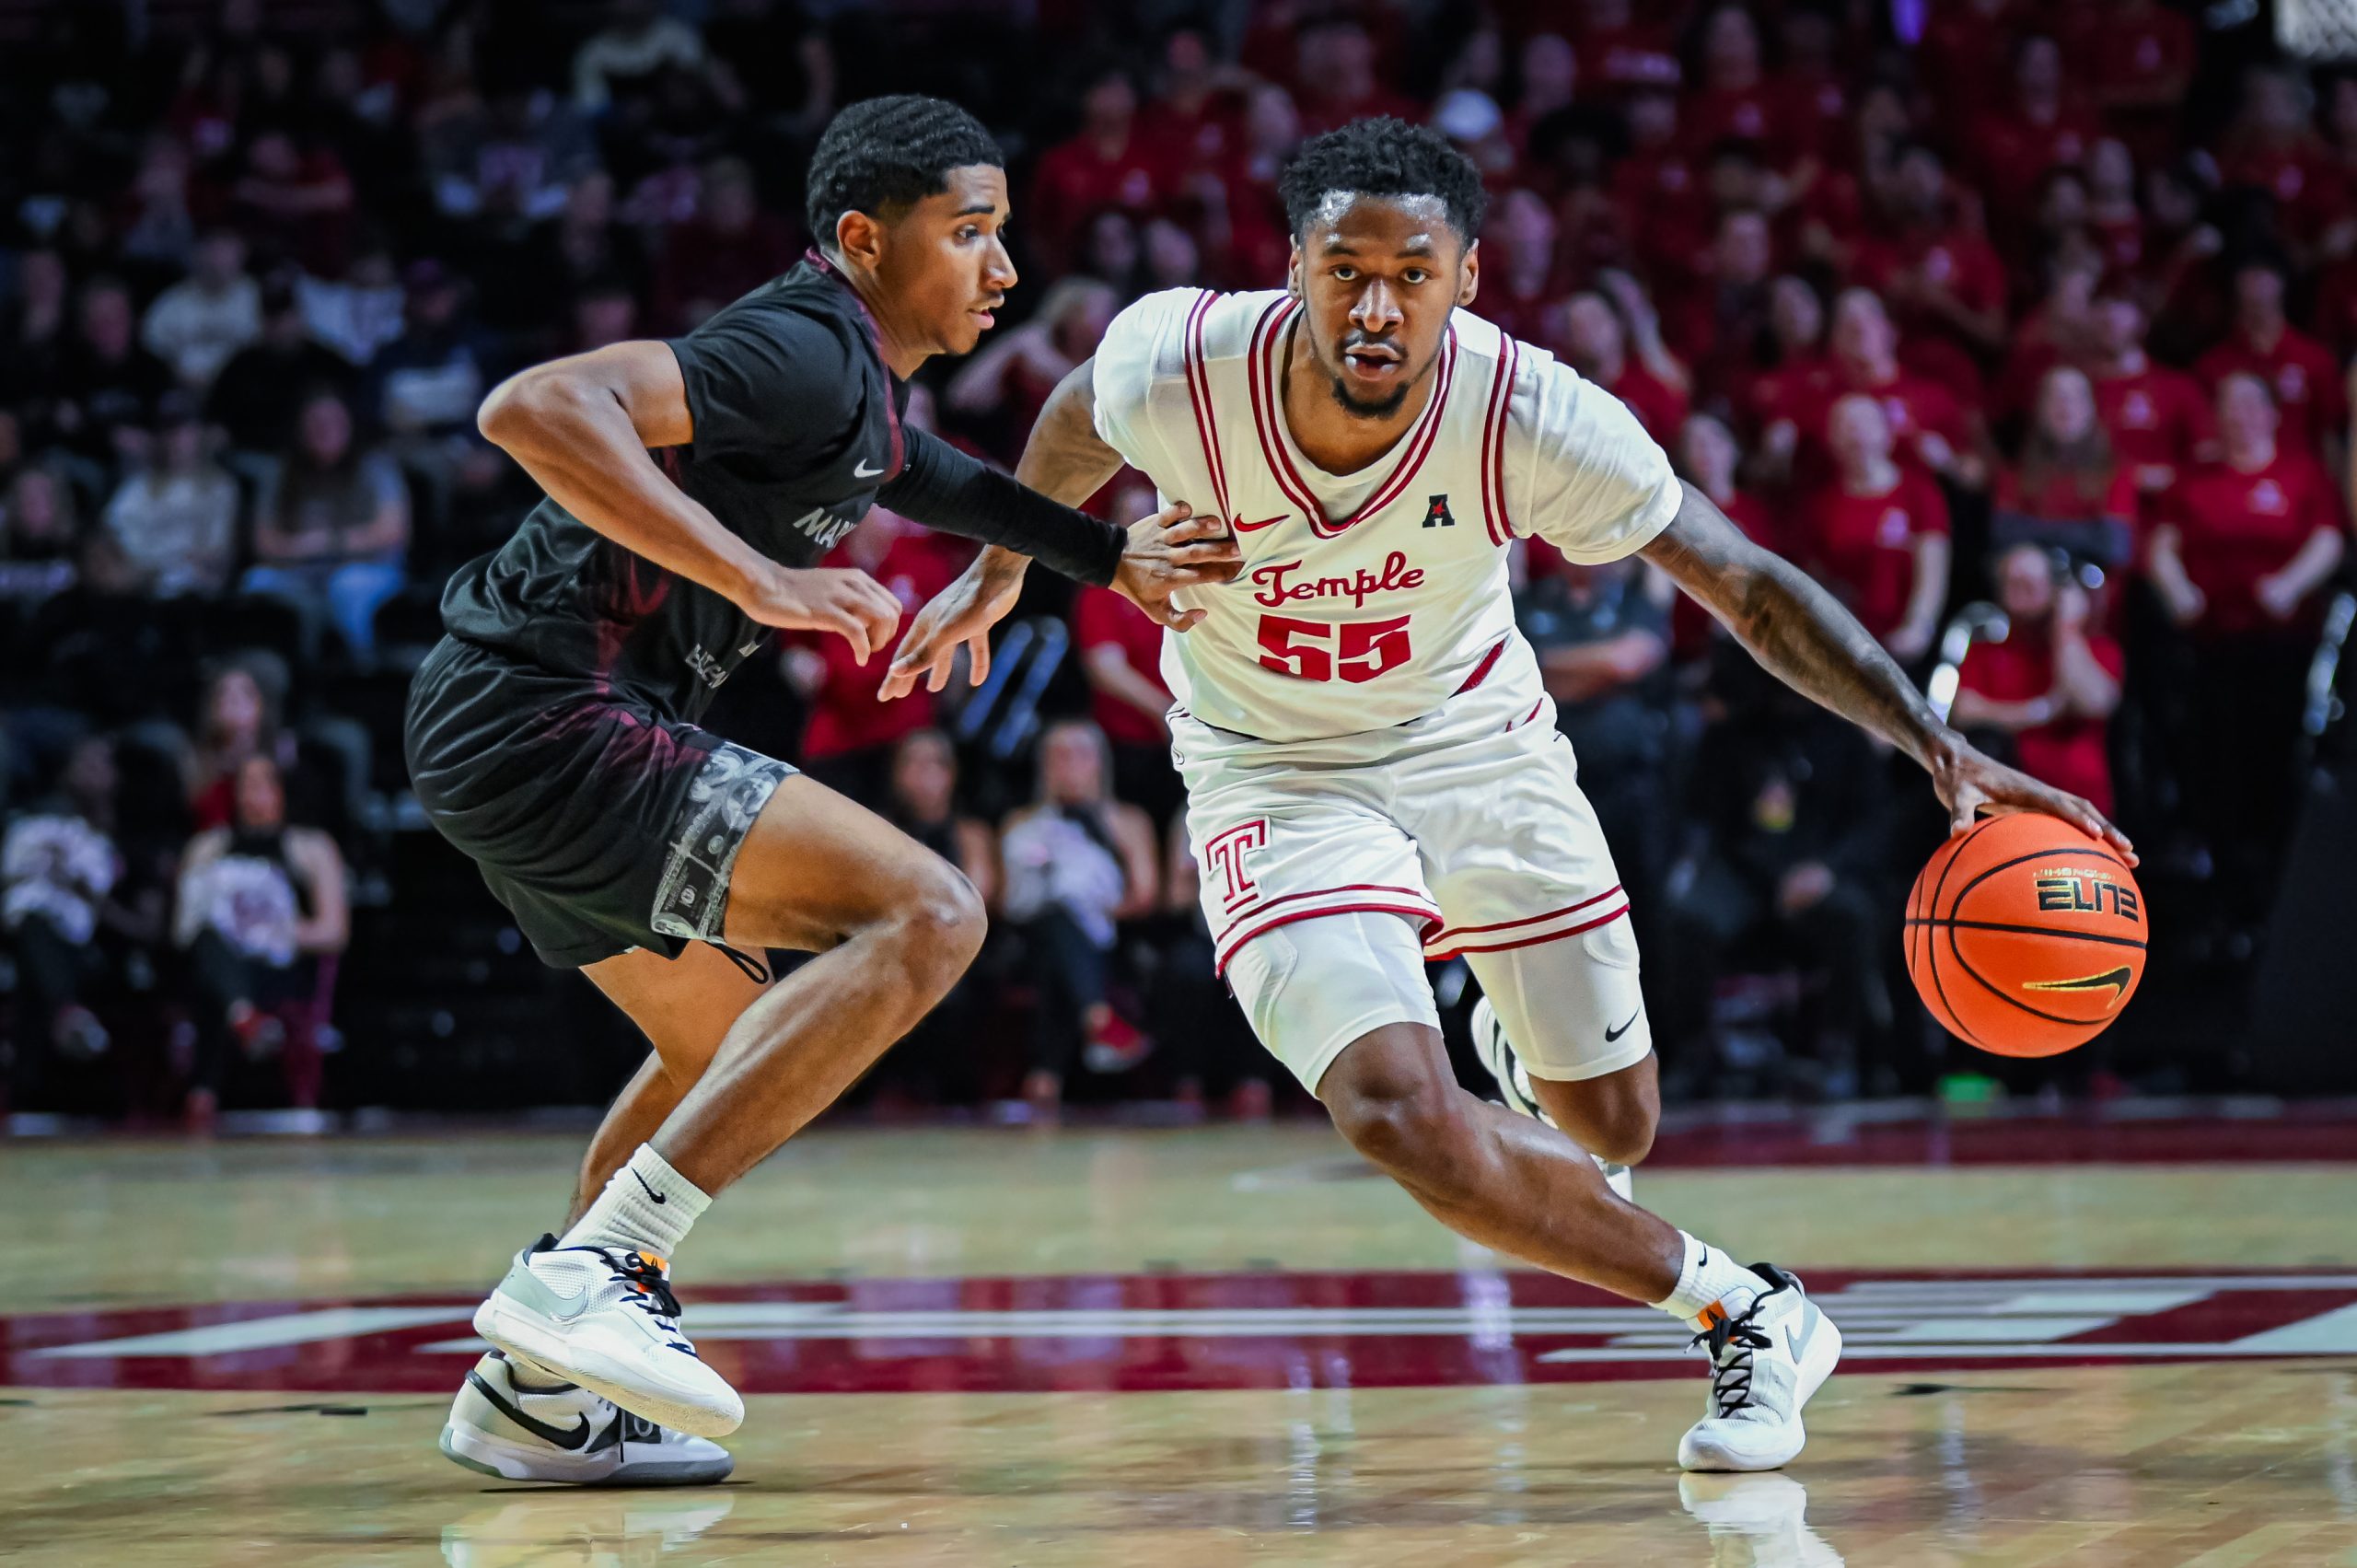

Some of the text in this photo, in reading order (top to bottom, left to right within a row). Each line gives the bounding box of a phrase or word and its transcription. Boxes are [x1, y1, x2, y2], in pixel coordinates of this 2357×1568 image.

[1422, 494, 1456, 528] A
[1251, 551, 1425, 610] Temple
[1257, 613, 1412, 684] 55
[1204, 819, 1266, 916] T
[2035, 877, 2140, 923] ELITE
